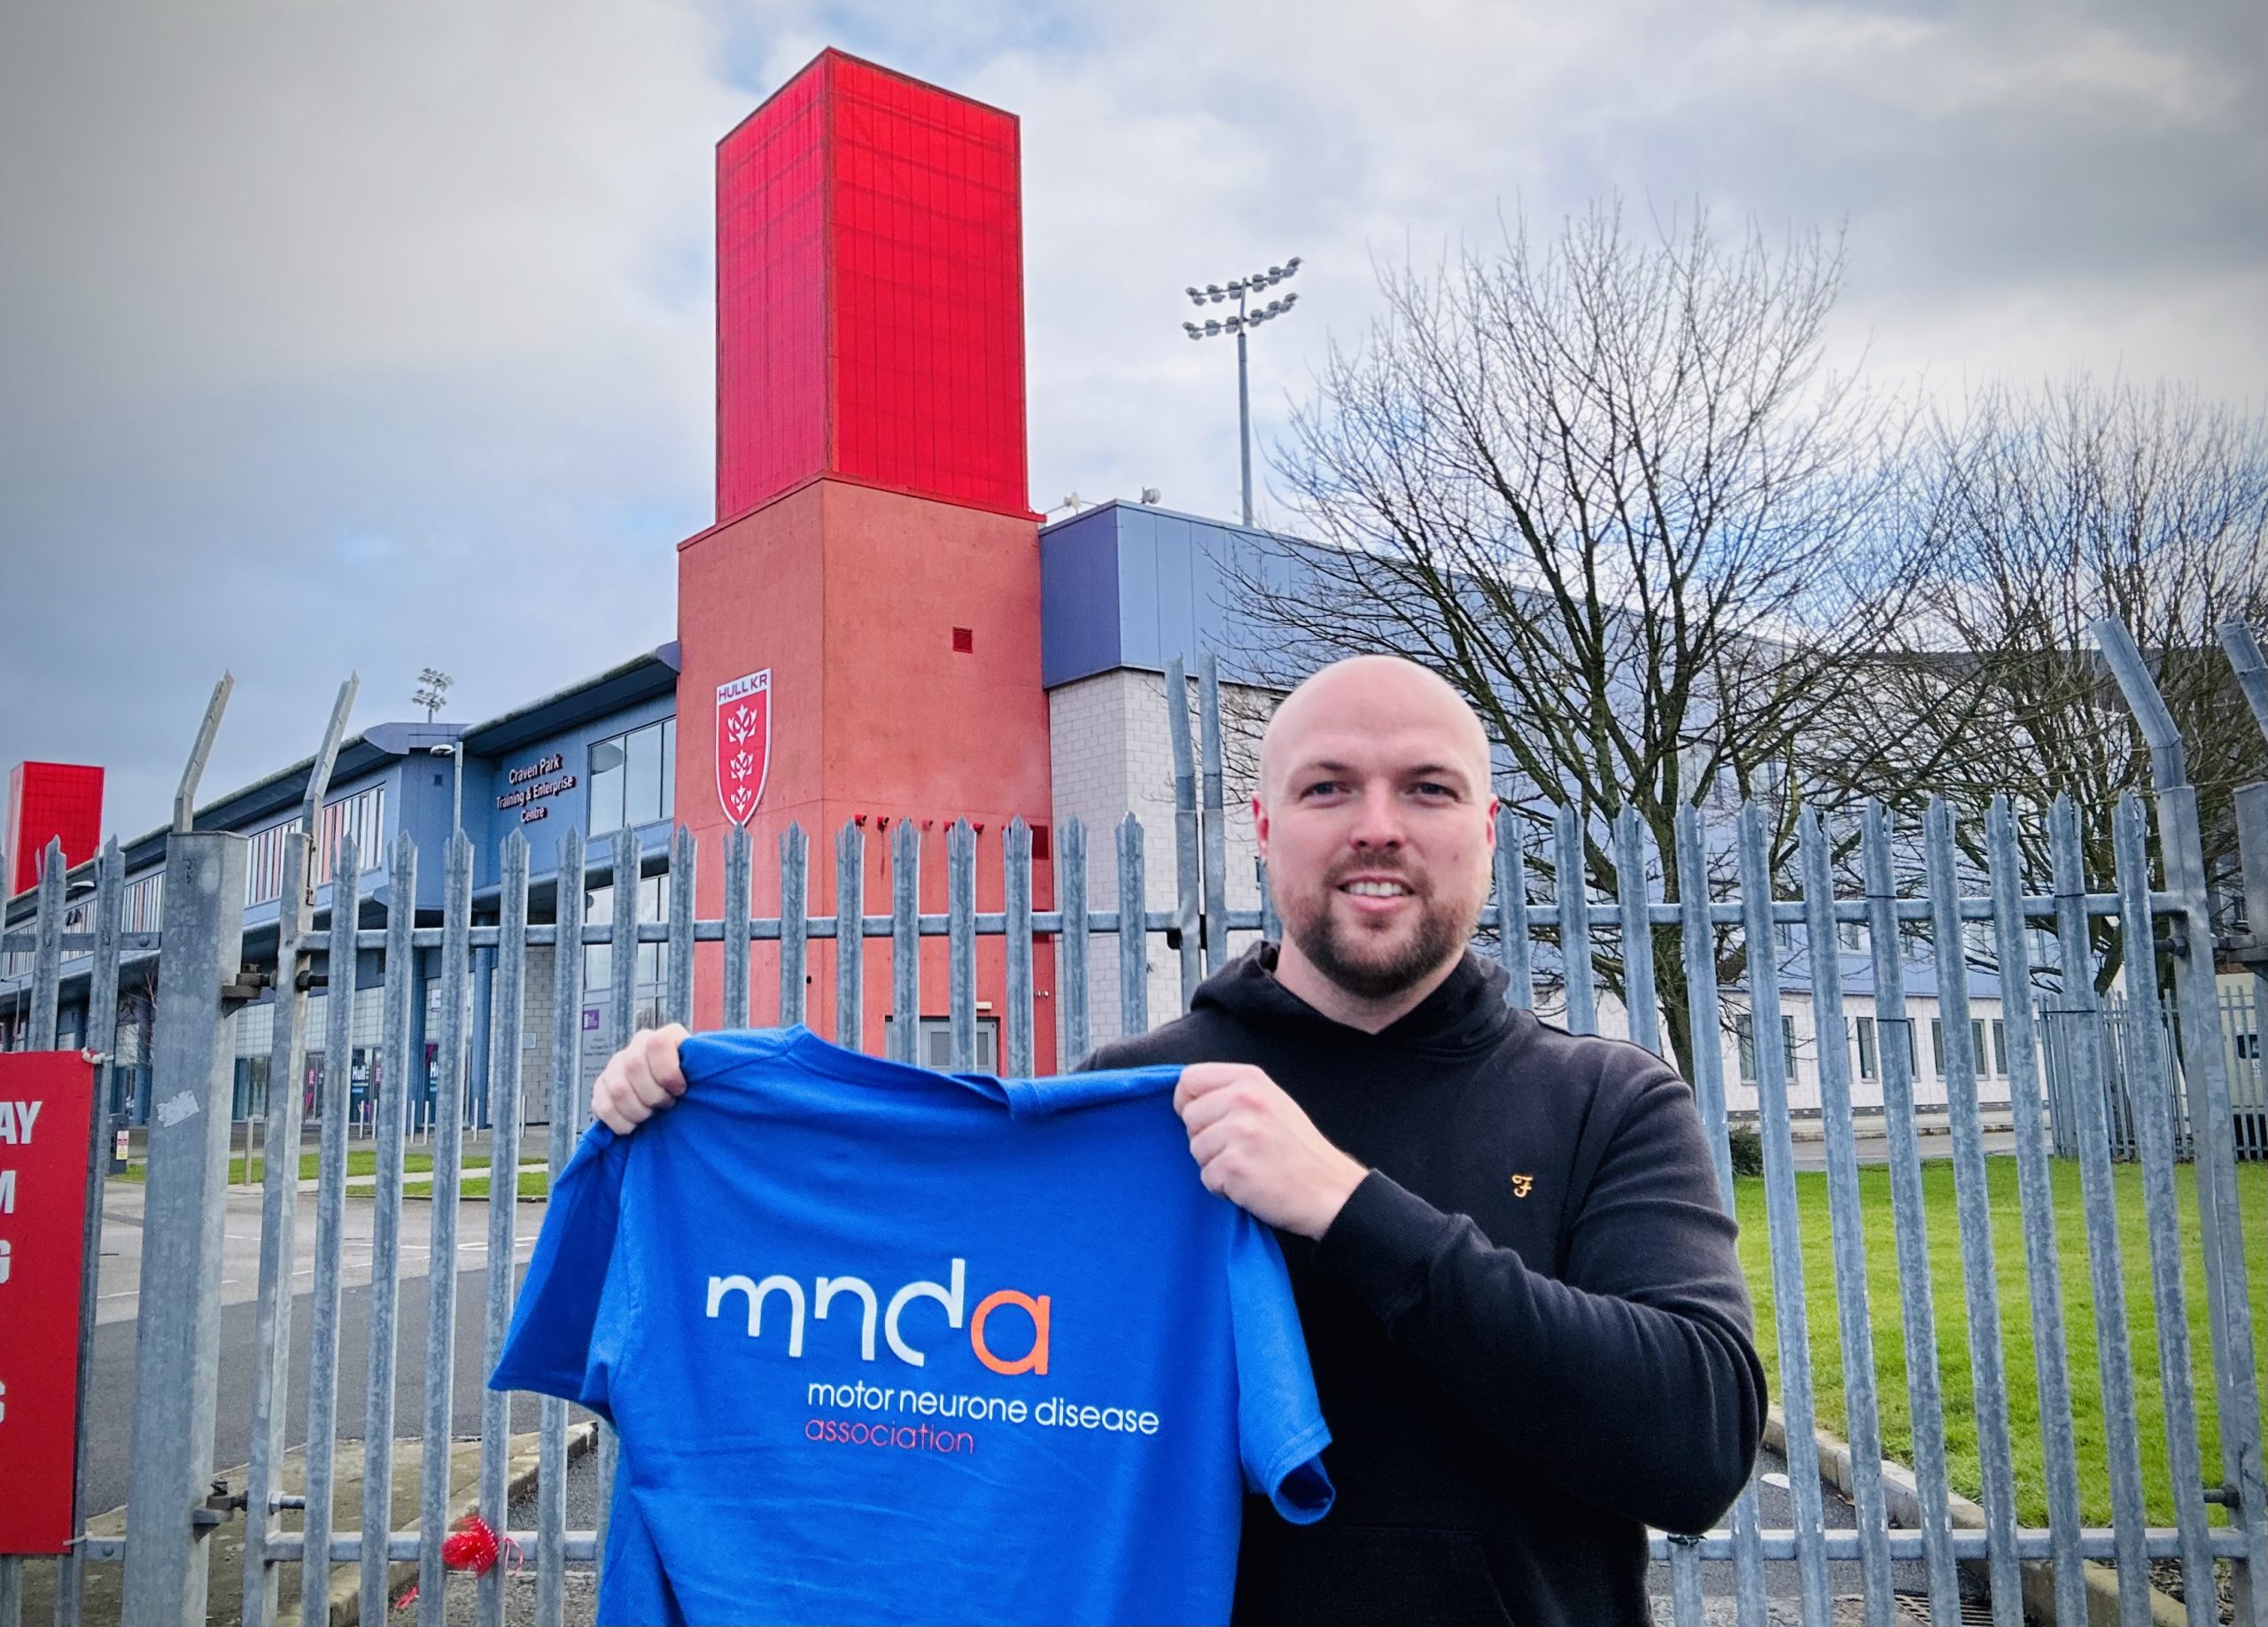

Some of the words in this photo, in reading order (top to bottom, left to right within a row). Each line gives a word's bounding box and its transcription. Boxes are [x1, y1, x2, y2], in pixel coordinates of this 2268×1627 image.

[718, 681, 749, 702] HULL
[750, 673, 767, 691] KR
[509, 764, 538, 784] Craven
[540, 753, 563, 775] Park
[496, 791, 526, 809] Training
[525, 788, 534, 801] &
[533, 775, 576, 796] Enterprise
[521, 807, 548, 823] Centre
[706, 1257, 1051, 1375] mnda
[807, 1380, 895, 1412] motor
[899, 1390, 1028, 1424] neurone
[1035, 1397, 1160, 1435] disease
[805, 1418, 975, 1454] association
